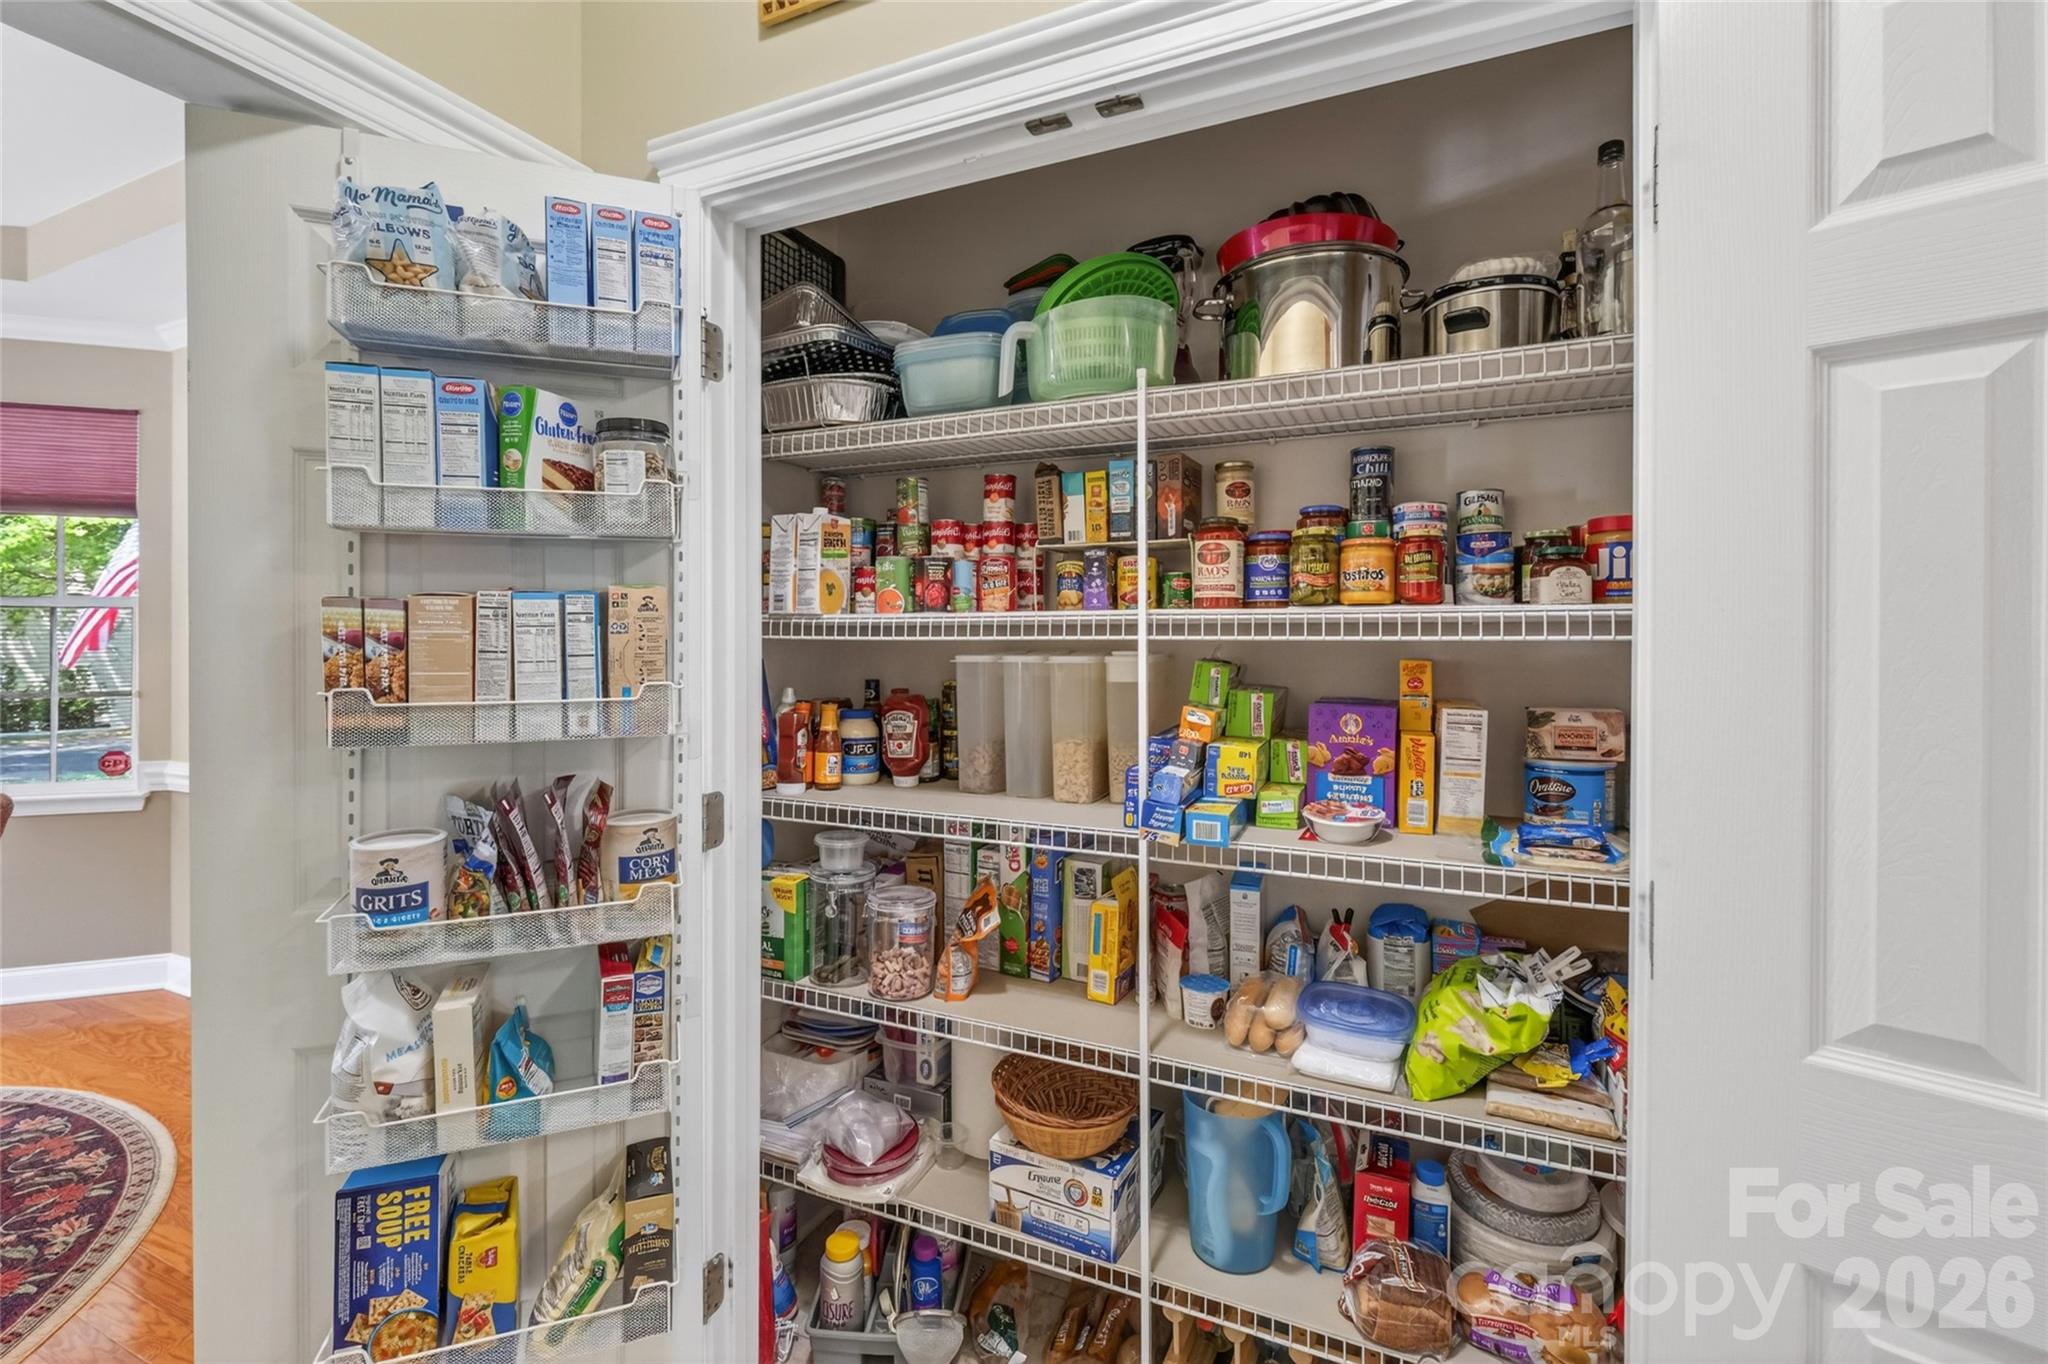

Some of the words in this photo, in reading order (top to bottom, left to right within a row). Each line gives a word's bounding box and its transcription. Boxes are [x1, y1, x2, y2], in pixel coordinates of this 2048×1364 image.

[1329, 734, 1374, 747] Annie's
[850, 743, 875, 756] JFG
[629, 853, 671, 870] CORN
[629, 866, 668, 881] MEAL
[360, 889, 423, 913] GRITS
[375, 1190, 403, 1248] SOUP
[404, 1185, 432, 1244] FREE
